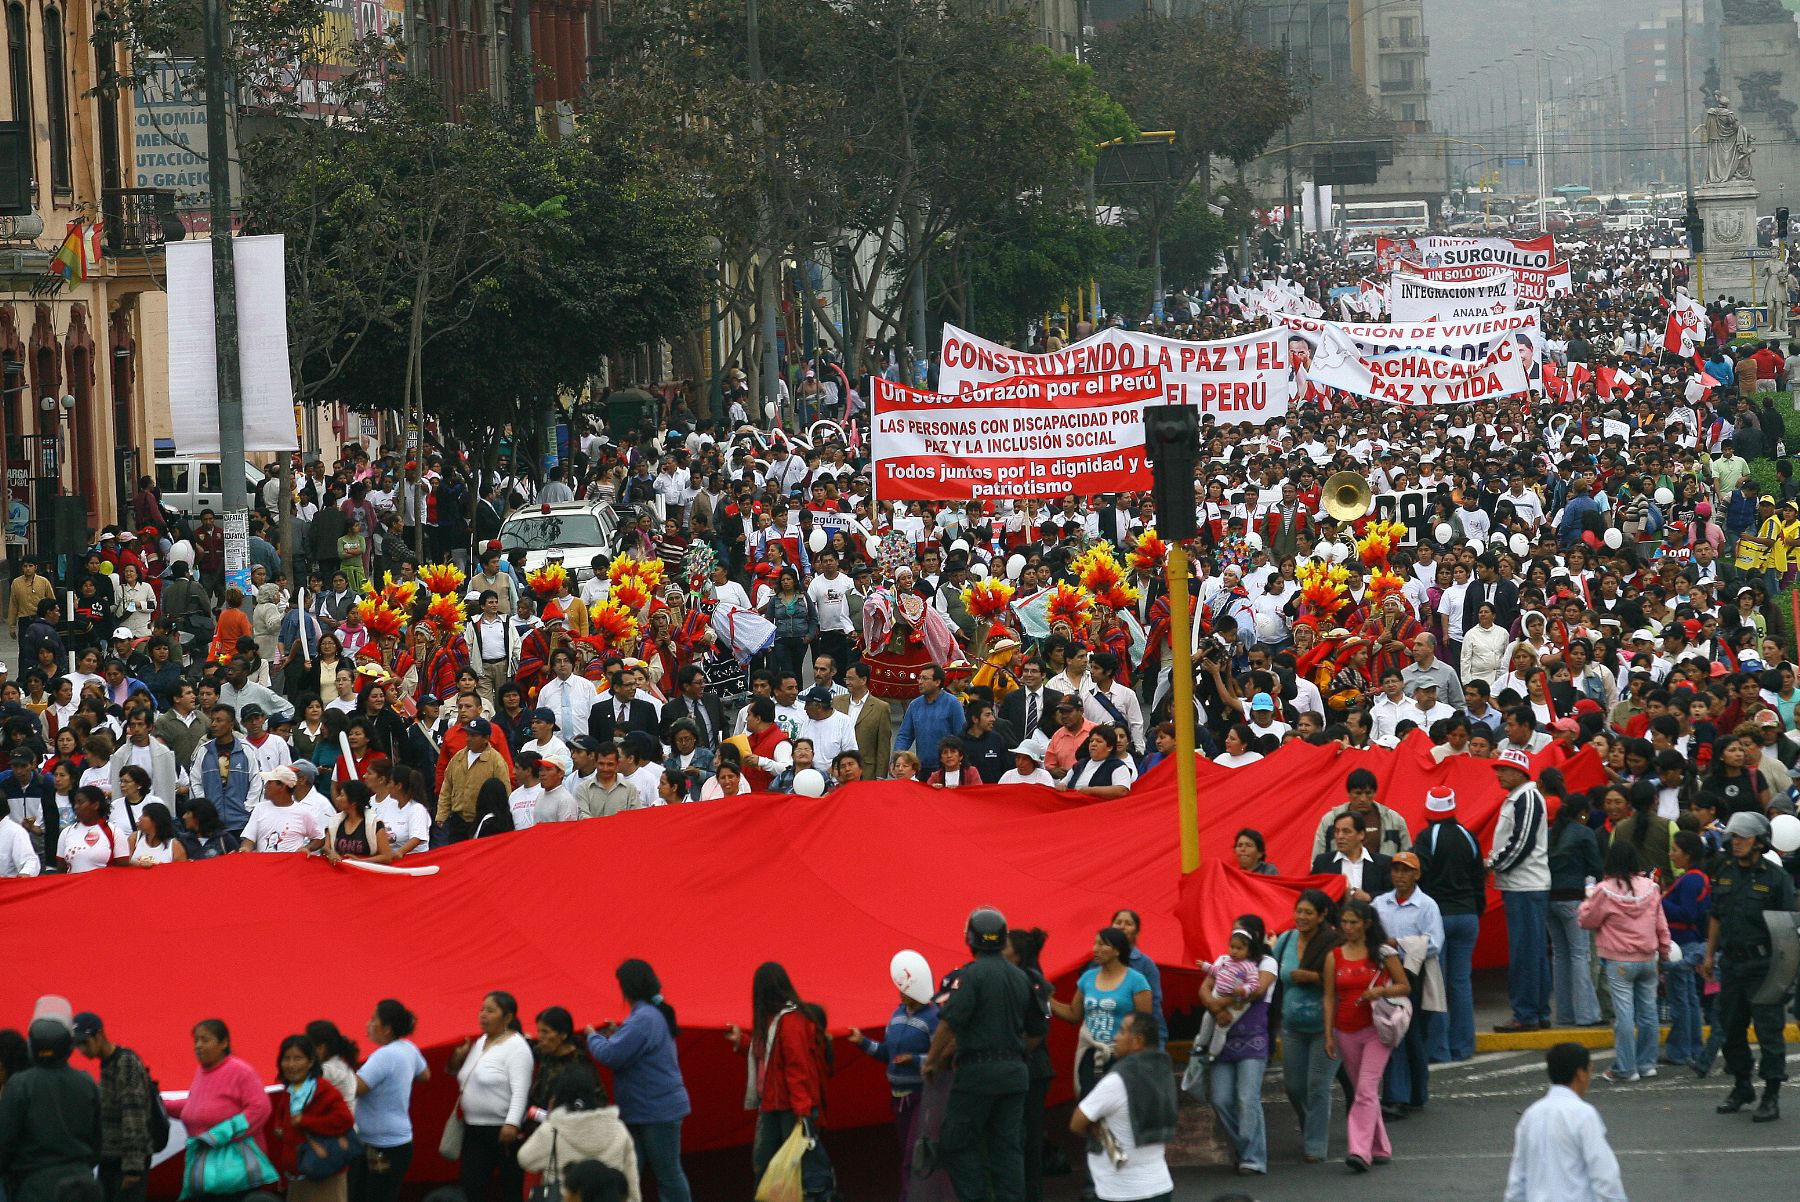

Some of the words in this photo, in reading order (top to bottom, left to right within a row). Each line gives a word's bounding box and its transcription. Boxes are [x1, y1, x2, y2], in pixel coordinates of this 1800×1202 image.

[135, 109, 207, 127] ONOMÍA
[1444, 248, 1548, 269] SURQUILLO
[1428, 271, 1443, 281] UN
[1445, 268, 1473, 280] SOLO
[1475, 266, 1520, 279] CORAZN
[1523, 271, 1544, 283] POR
[1477, 286, 1485, 298] Y
[1487, 282, 1507, 298] PAZ
[1453, 308, 1489, 317] ANAPA
[1410, 326, 1436, 339] DE
[1442, 313, 1537, 337] VIVIENDA
[943, 337, 1136, 376] CONSTRUYENDO
[1143, 344, 1174, 374] LA
[1180, 346, 1228, 373] PAZ
[1233, 344, 1250, 371] Y
[1256, 340, 1285, 370] EL
[881, 382, 907, 402] Un
[1046, 380, 1080, 401] por
[1085, 374, 1104, 395] el
[1110, 370, 1157, 392] Perú
[1201, 372, 1267, 412] PERÚ
[1369, 374, 1415, 405] PAZ
[1420, 384, 1438, 405] Y
[1445, 371, 1504, 402] VIDA
[879, 419, 905, 433] LAS
[908, 419, 977, 436] PERSONAS
[981, 418, 1009, 434] CON
[1013, 411, 1108, 433] DISCAPACIDAD
[1112, 409, 1139, 426] POR
[924, 438, 949, 454] PAZ
[952, 440, 961, 455] Y
[965, 439, 983, 454] LA
[987, 432, 1062, 453] INCLUSIÓN
[1066, 431, 1117, 449] SOCIAL
[884, 463, 936, 479] Todos
[939, 463, 993, 483] juntos
[997, 465, 1026, 483] por
[1030, 461, 1046, 477] la
[1051, 454, 1124, 478] dignidad
[1128, 456, 1139, 474] y
[972, 479, 1073, 499] patriotismo
